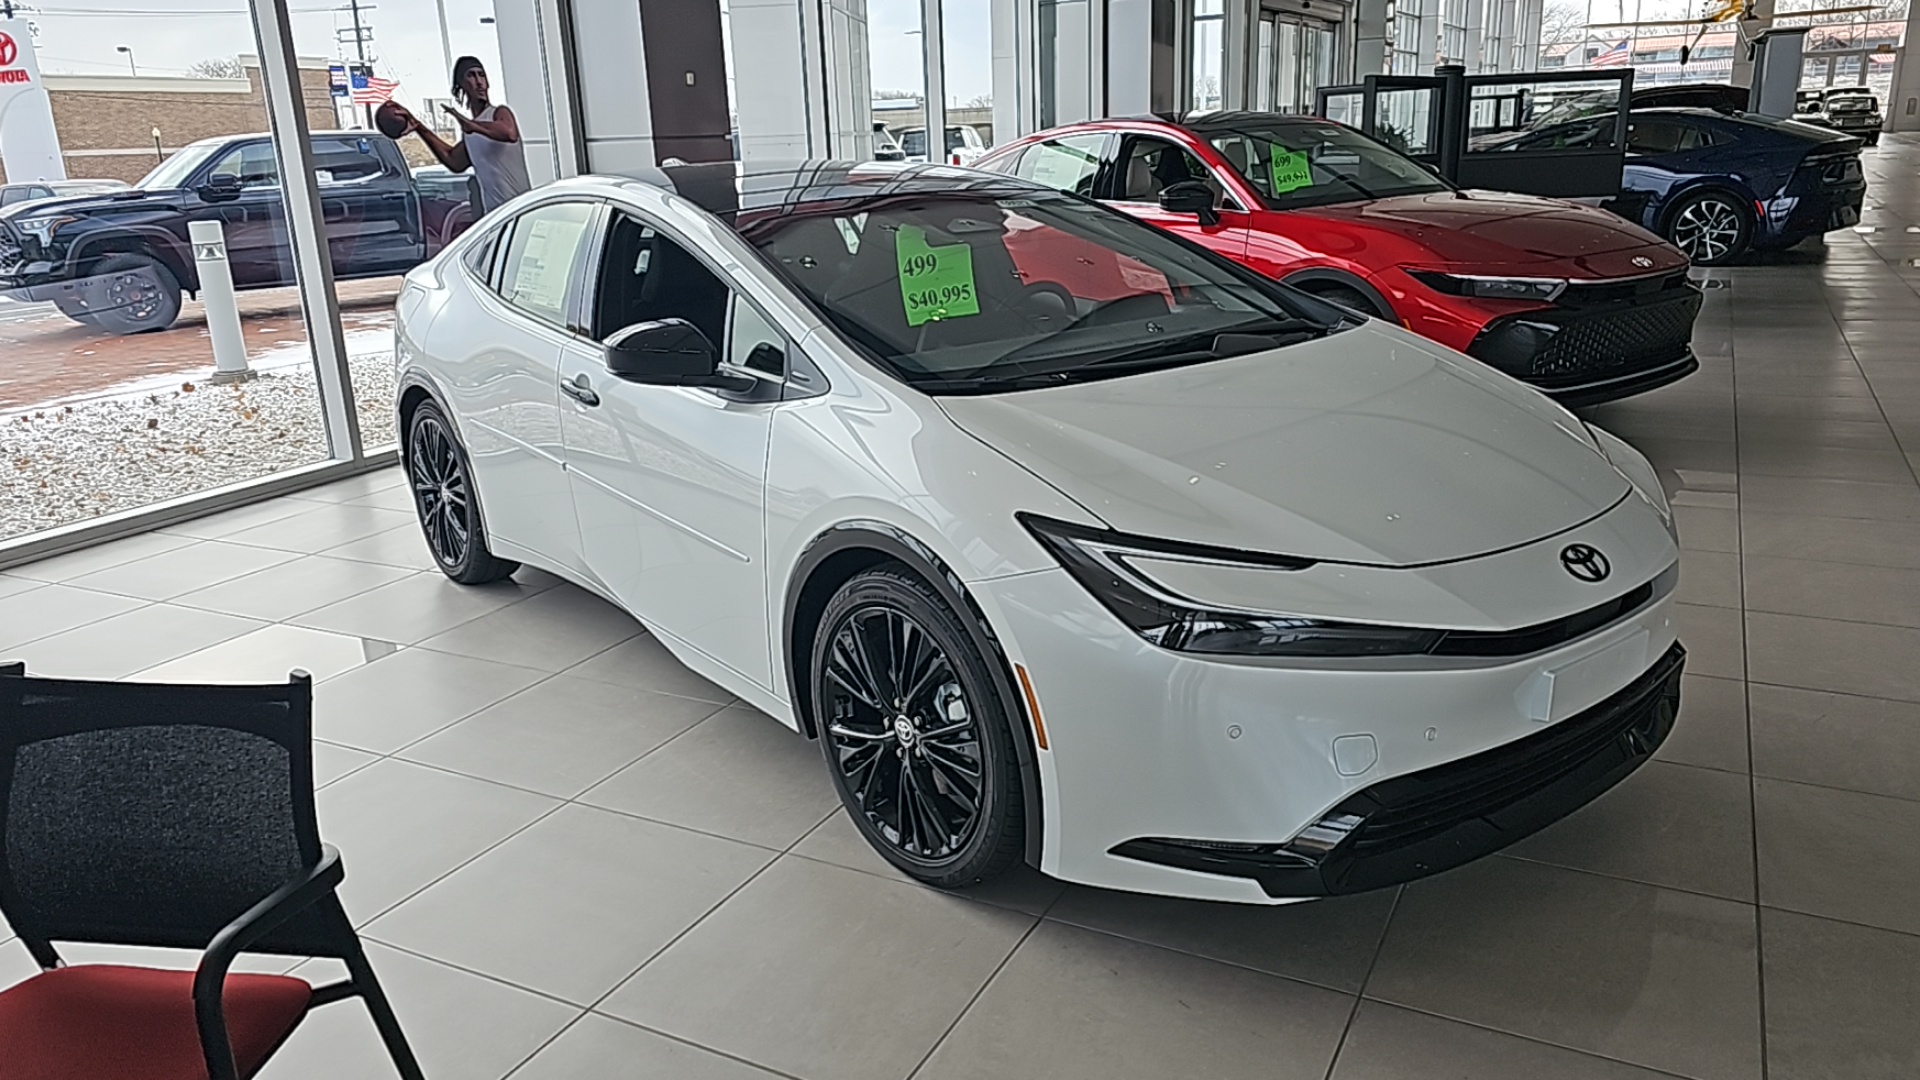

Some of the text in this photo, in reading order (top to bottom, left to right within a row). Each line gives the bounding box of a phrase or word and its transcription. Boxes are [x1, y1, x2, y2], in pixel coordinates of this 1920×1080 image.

[1274, 155, 1291, 168] 699
[903, 254, 937, 277] 499
[908, 284, 971, 310] $40,995
